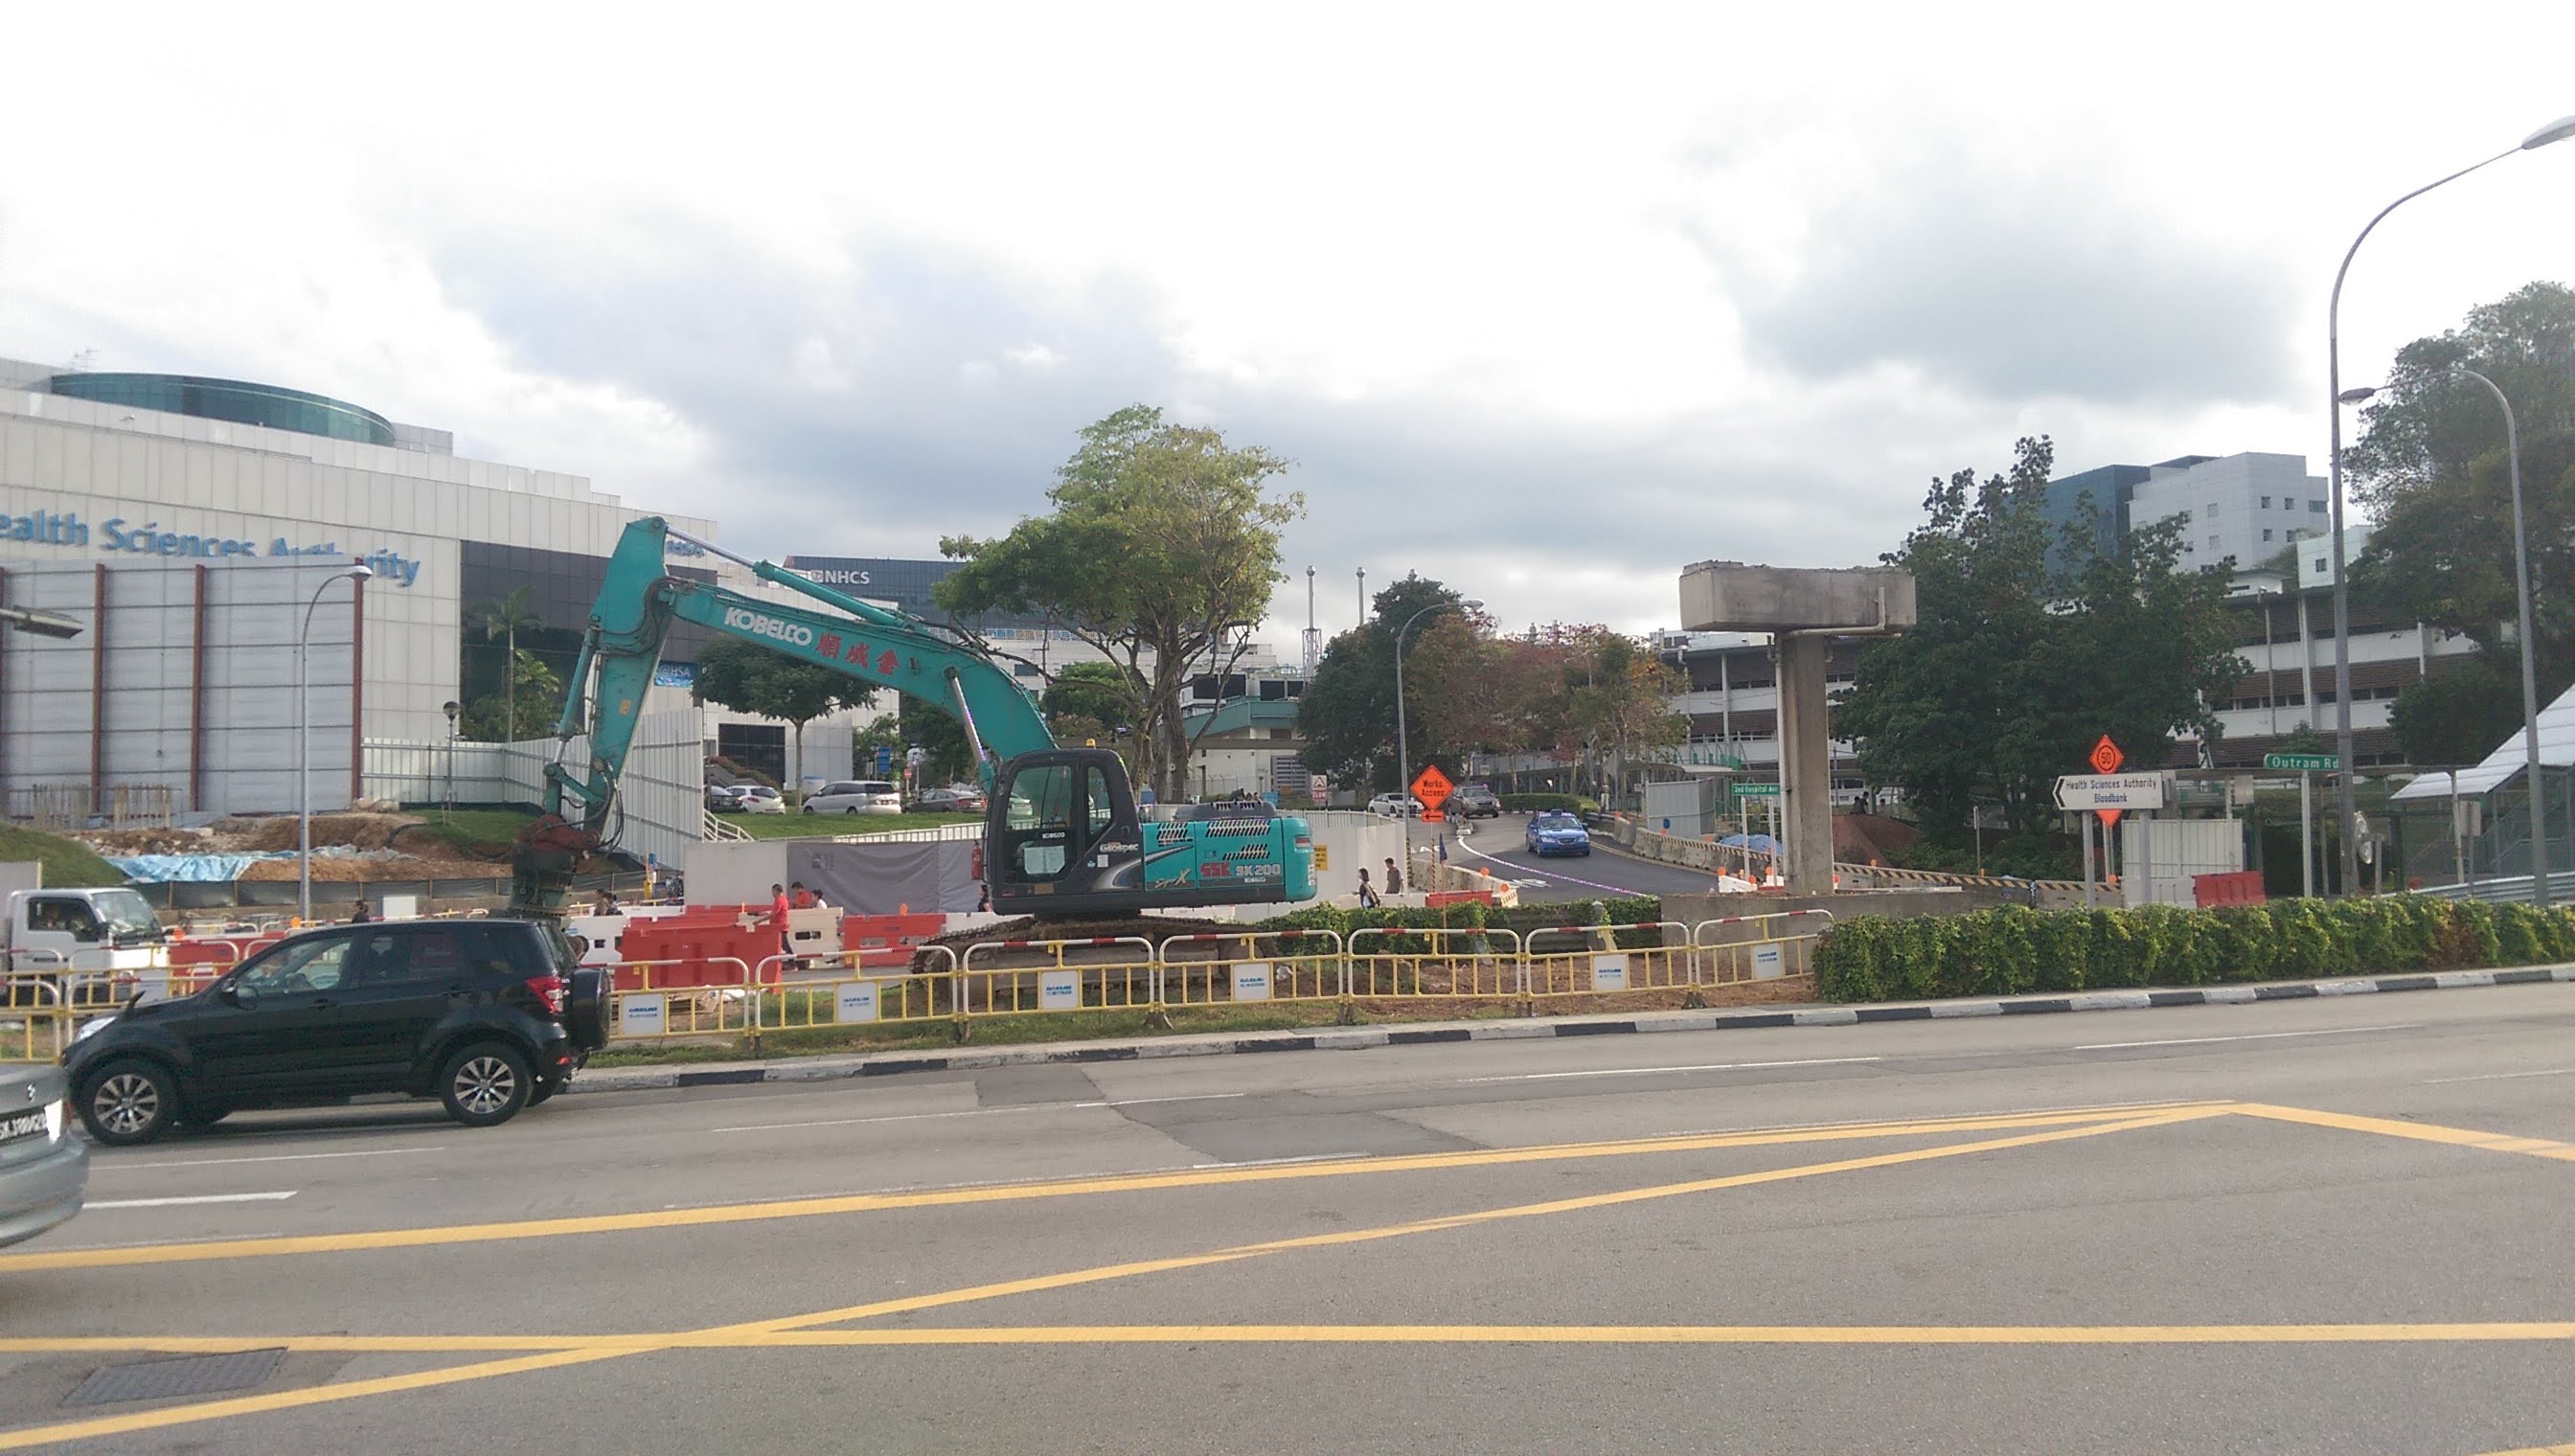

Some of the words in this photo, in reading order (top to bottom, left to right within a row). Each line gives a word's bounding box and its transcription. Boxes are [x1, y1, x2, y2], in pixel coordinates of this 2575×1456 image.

[99, 517, 257, 557] Sciences
[825, 570, 870, 585] NHCS
[724, 607, 813, 647] KOBELCO
[2101, 752, 2111, 764] 50
[2271, 756, 2320, 768] Outram
[2324, 758, 2339, 769] Rd
[1423, 779, 1443, 788] Works
[2066, 780, 2087, 790] Health
[2090, 780, 2120, 789] Sciences
[2124, 778, 2157, 790] Authority
[1421, 788, 1445, 797] Access
[2094, 793, 2128, 804] Bloodbank
